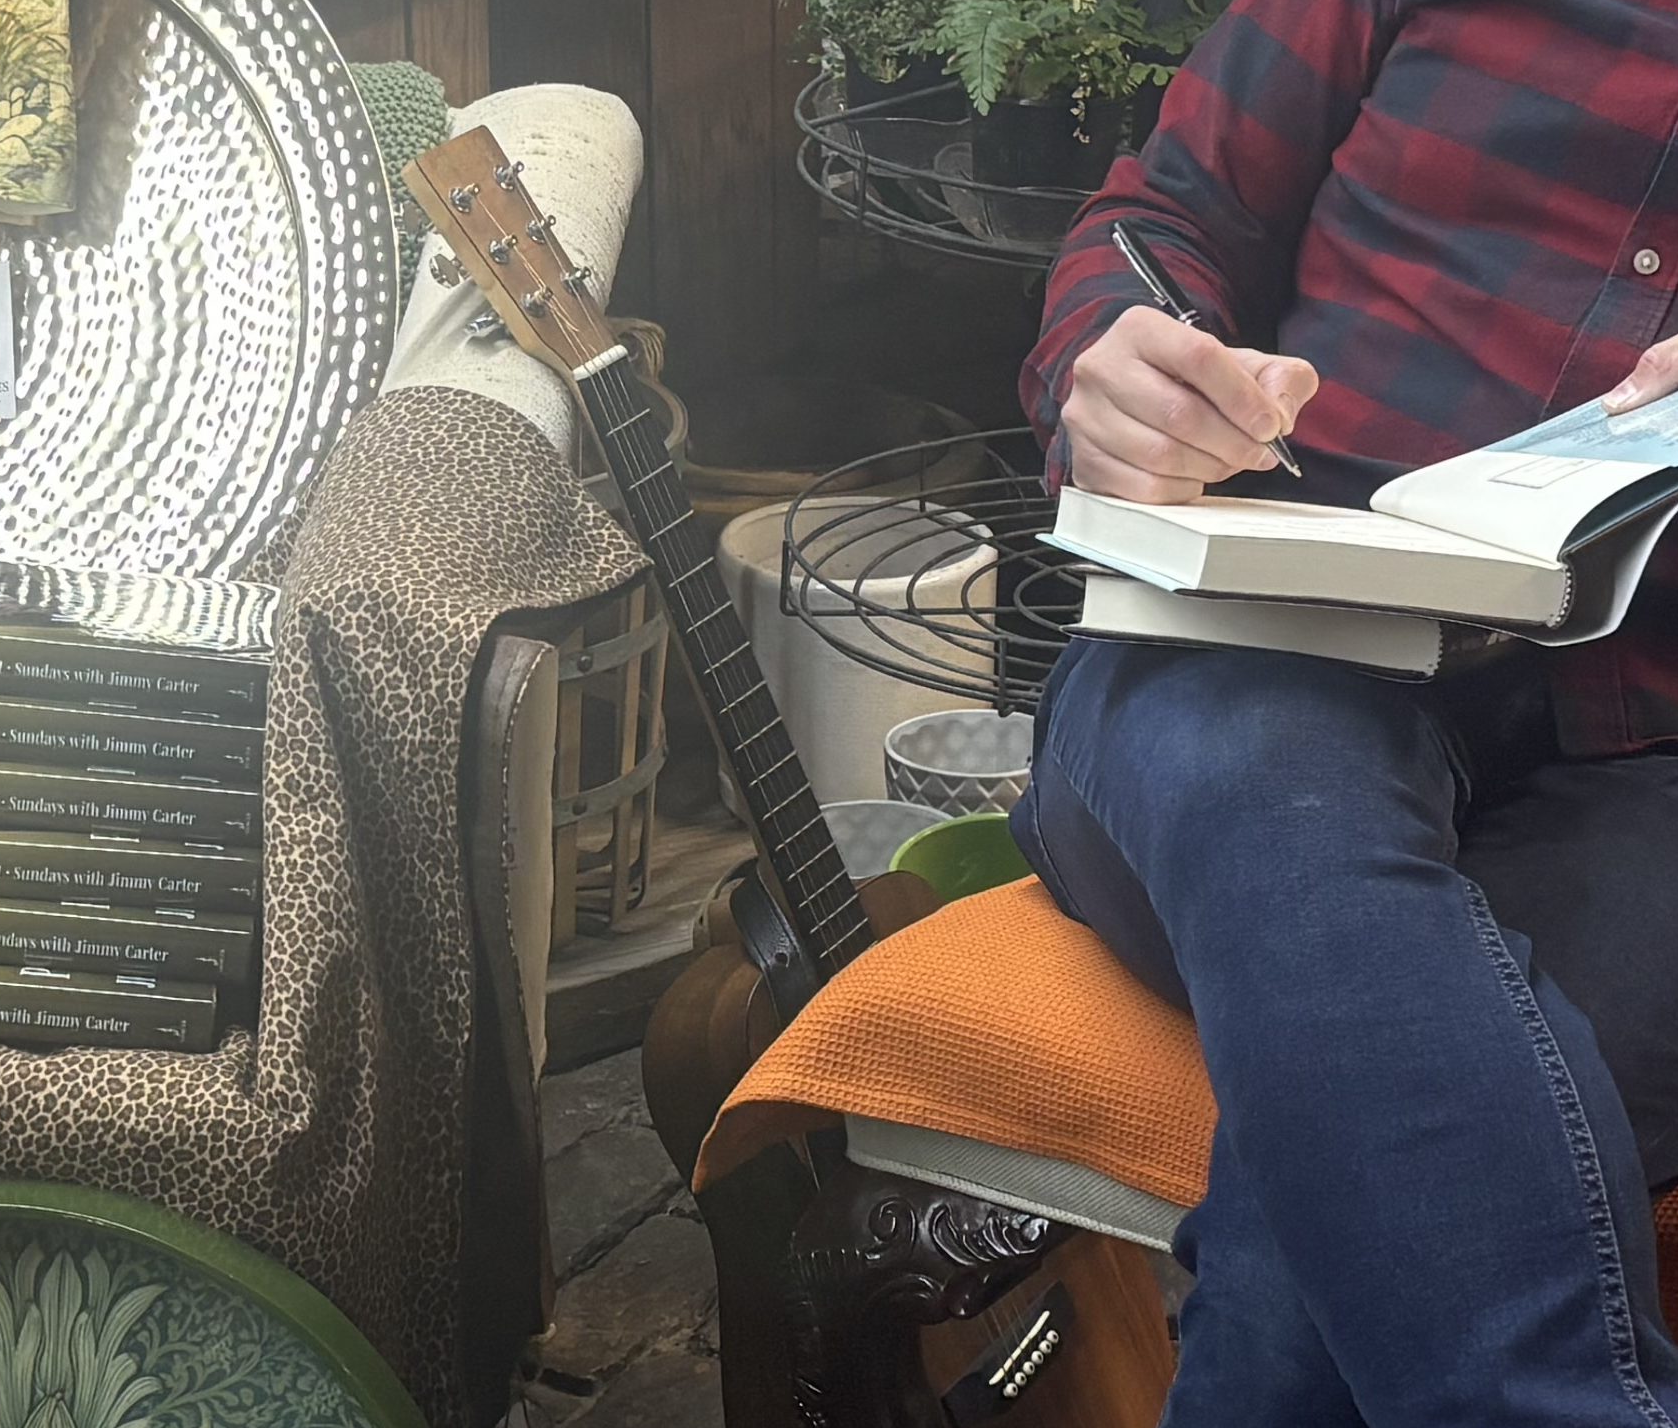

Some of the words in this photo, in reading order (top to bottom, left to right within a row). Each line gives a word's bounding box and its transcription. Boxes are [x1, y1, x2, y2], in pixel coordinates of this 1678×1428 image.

[15, 662, 69, 681] Sundays
[74, 668, 104, 685] with
[107, 671, 152, 691] Jimmy
[157, 677, 200, 694] Carter
[9, 728, 66, 748] Sundays
[69, 734, 100, 750] with
[103, 737, 148, 756] Jimmy
[152, 742, 196, 760] Carter
[9, 795, 65, 816] Sundays
[69, 800, 99, 817] with
[103, 804, 148, 823] Jimmy
[152, 808, 196, 826] Carter
[13, 866, 70, 884] Sundays
[74, 870, 105, 887] with
[108, 872, 153, 891] Jimmy
[158, 876, 202, 893] Carter
[40, 935, 71, 953] with
[74, 940, 120, 959] Jimmy
[124, 944, 169, 962] Carter
[0, 1006, 30, 1023] with
[34, 1010, 82, 1028] Jimmy
[85, 1014, 130, 1033] Carter
